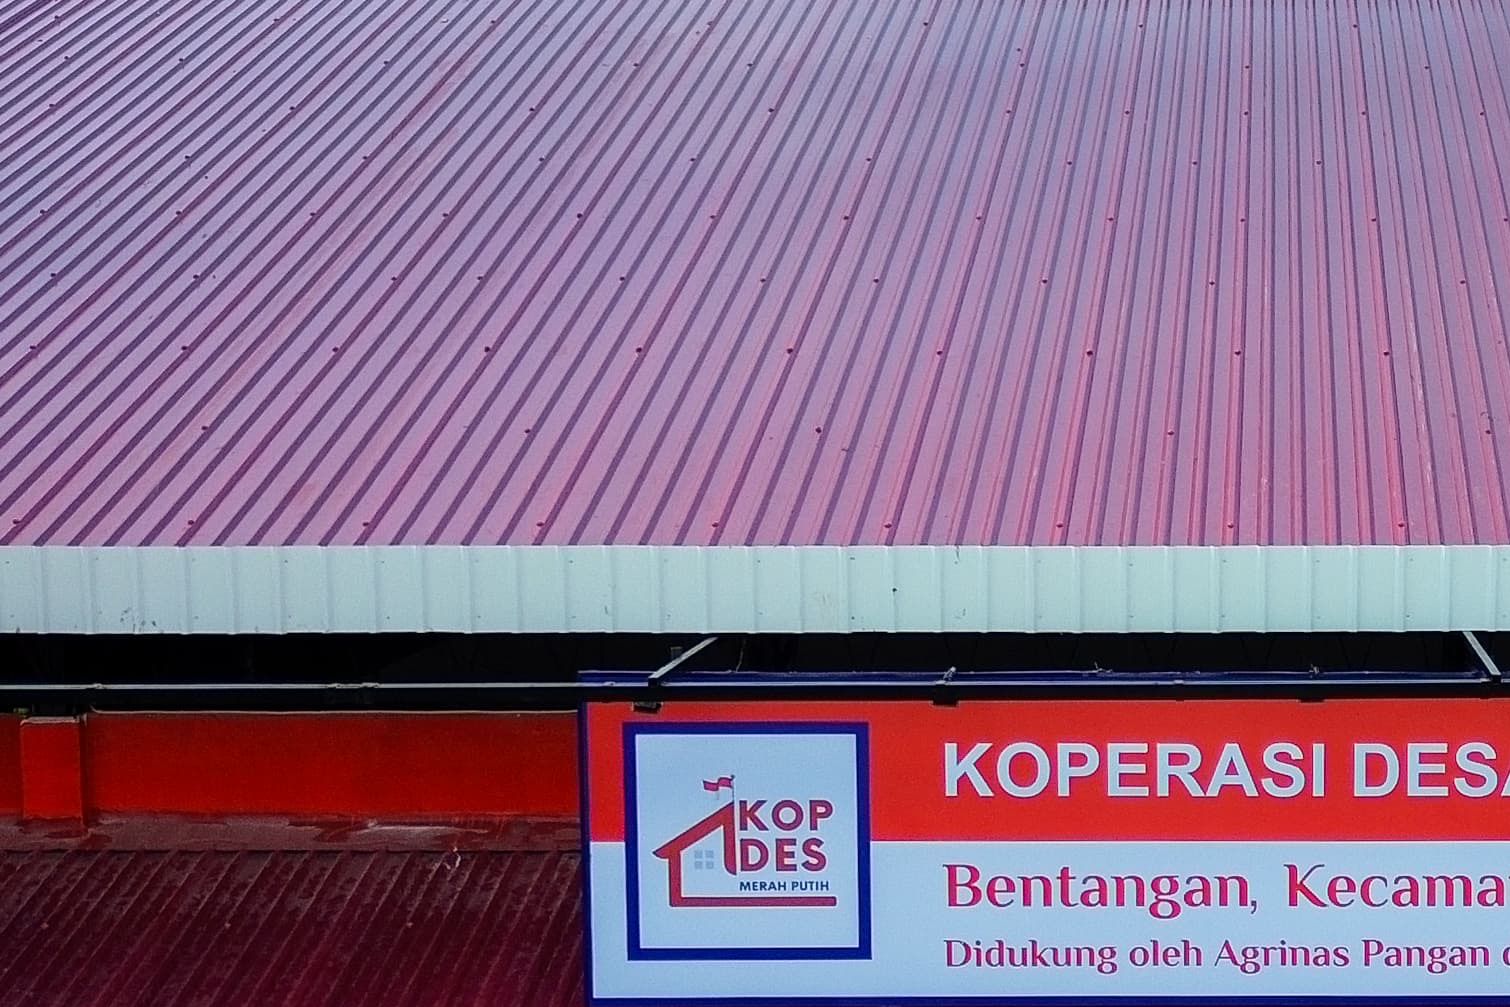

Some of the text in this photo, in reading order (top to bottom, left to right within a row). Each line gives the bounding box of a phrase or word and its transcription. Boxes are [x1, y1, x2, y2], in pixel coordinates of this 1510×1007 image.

[943, 742, 1326, 798] KOPERASI
[738, 799, 834, 831] KOP
[739, 837, 828, 872] DES
[739, 881, 830, 891] MERAH PUTIH
[942, 863, 1258, 920] Bentangan,
[943, 939, 1118, 975] Didukung
[1129, 939, 1201, 968] oleh
[1213, 939, 1350, 975] Agrinas
[1361, 939, 1490, 975] Pangan
